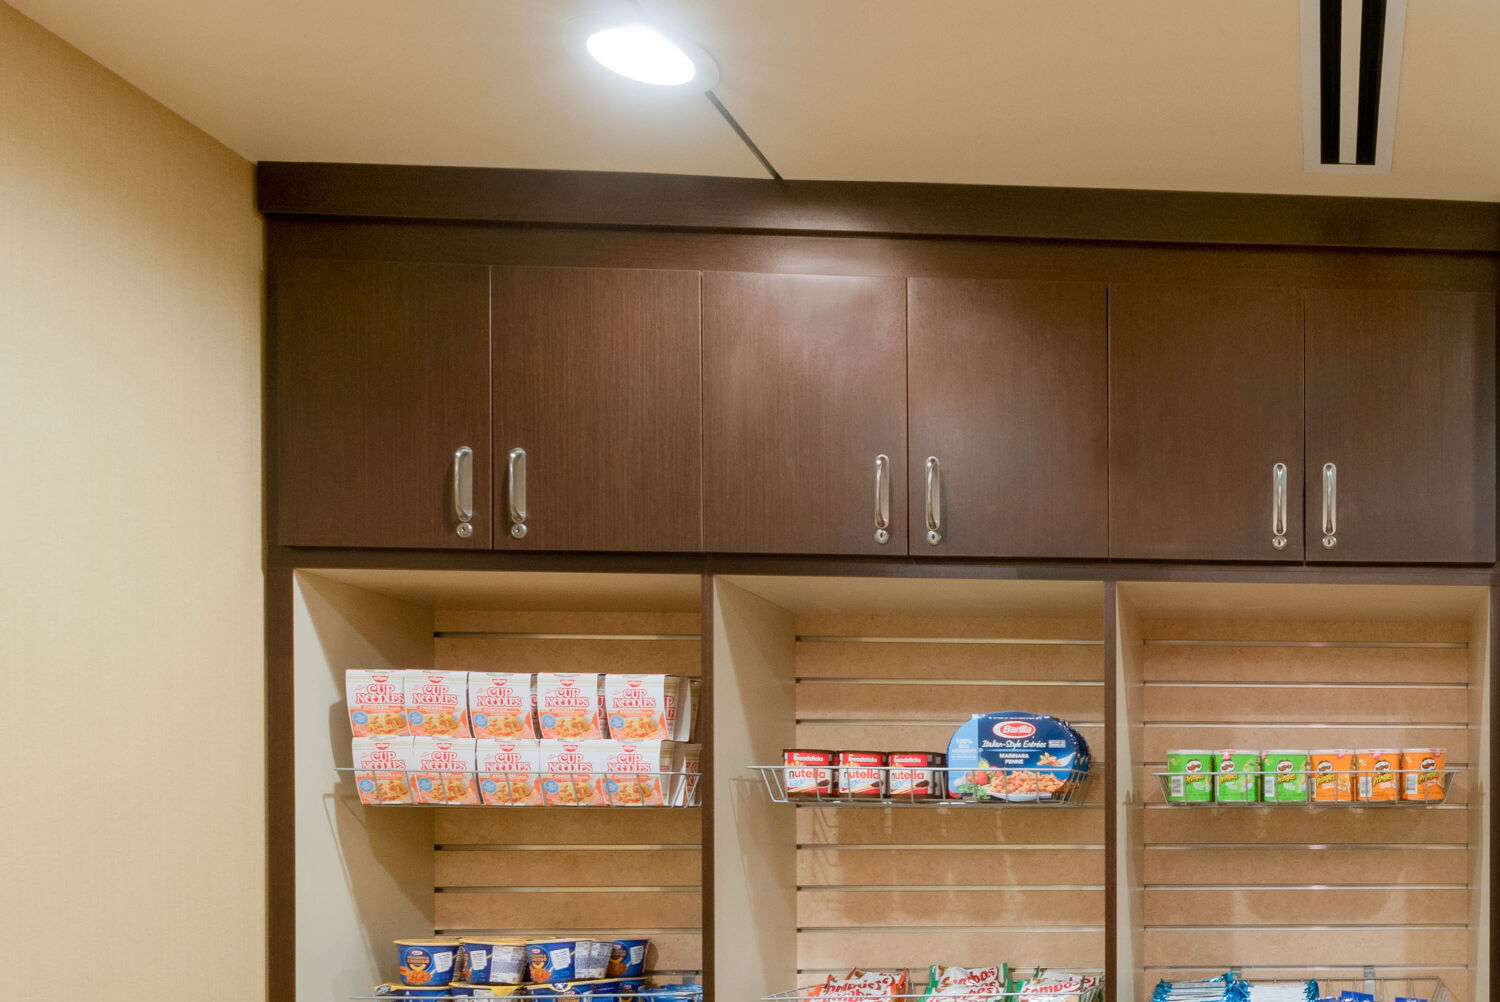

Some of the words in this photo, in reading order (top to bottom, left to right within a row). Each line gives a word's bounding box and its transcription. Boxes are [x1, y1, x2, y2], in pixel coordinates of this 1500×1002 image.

[366, 684, 395, 695] CUP
[422, 684, 449, 695] CUP
[486, 687, 514, 698] CUP
[554, 688, 580, 698] CUP
[622, 688, 648, 700] CUP
[355, 693, 405, 704] NOODLES
[412, 693, 458, 705] NOODLES
[476, 696, 522, 707] NOODLES
[544, 696, 590, 708] NOODLES
[612, 698, 656, 708] NOODLES
[1002, 724, 1032, 734] Barilla
[982, 740, 1022, 750] Italian-Style
[370, 751, 396, 762] CUP
[431, 751, 458, 762] CUP
[494, 753, 522, 764] CUP
[558, 753, 584, 764] CUP
[616, 754, 642, 764] CUP
[360, 760, 407, 770] NOODLES
[420, 760, 467, 770] NOODLES
[484, 762, 532, 772] NOODLES
[548, 762, 594, 772] NOODLES
[608, 762, 652, 772] NOODLES
